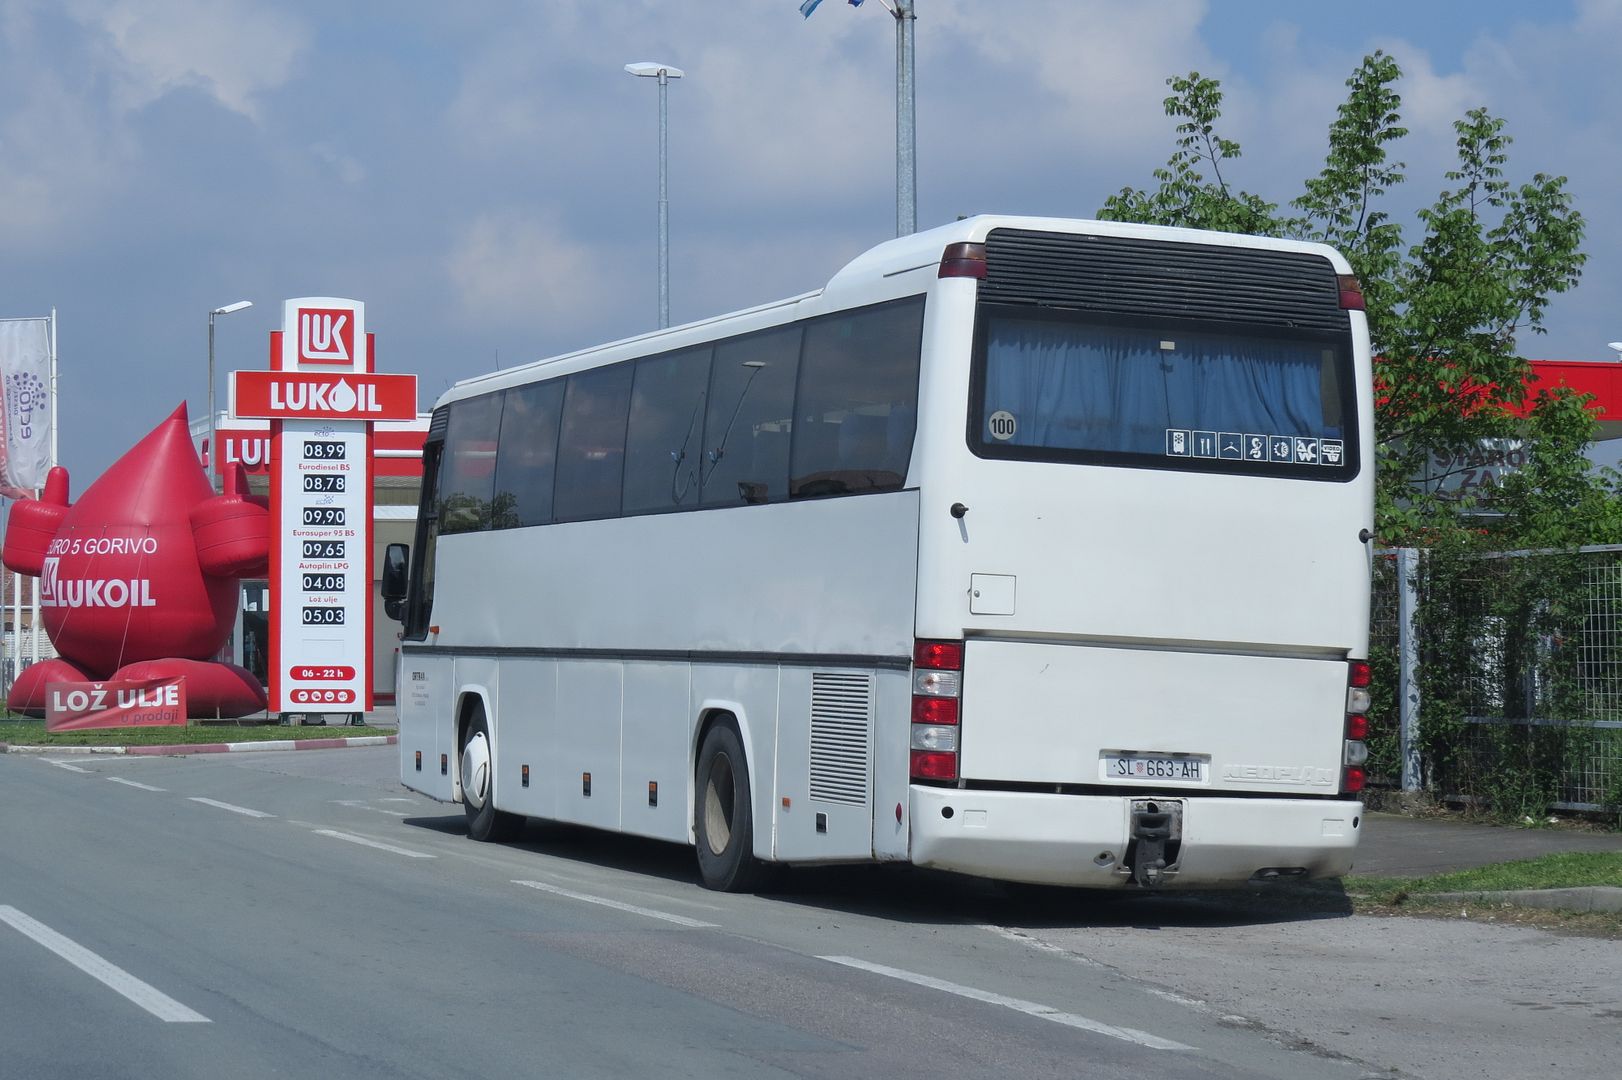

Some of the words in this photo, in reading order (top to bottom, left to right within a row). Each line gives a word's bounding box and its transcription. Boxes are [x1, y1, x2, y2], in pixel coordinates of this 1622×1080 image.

[270, 377, 382, 412] LUKOIL
[991, 417, 1014, 435] 100
[304, 444, 345, 458] 08,99
[298, 463, 339, 471] Eurodiesel
[339, 463, 351, 471] BS
[304, 477, 345, 491] 08,78
[303, 510, 345, 524] 09,90
[292, 529, 332, 537] Eurosuper
[333, 529, 343, 537] 95
[344, 529, 355, 537] BS
[47, 539, 71, 555] URO
[71, 539, 82, 554] 5
[84, 537, 158, 555] GORIVO
[303, 543, 344, 557] 09,65
[299, 562, 332, 570] Autoplin
[333, 562, 349, 570] LPG
[303, 576, 345, 590] 04,08
[58, 579, 156, 608] LUKOIL
[323, 596, 338, 604] ulje
[303, 609, 344, 623] 05,03
[302, 669, 314, 678] 06
[323, 669, 335, 678] 22
[337, 669, 344, 678] h
[53, 684, 108, 712] LOŽ
[117, 685, 179, 709] ULJE
[121, 715, 129, 723] u
[133, 709, 178, 725] prodaji
[1117, 759, 1135, 776] SL
